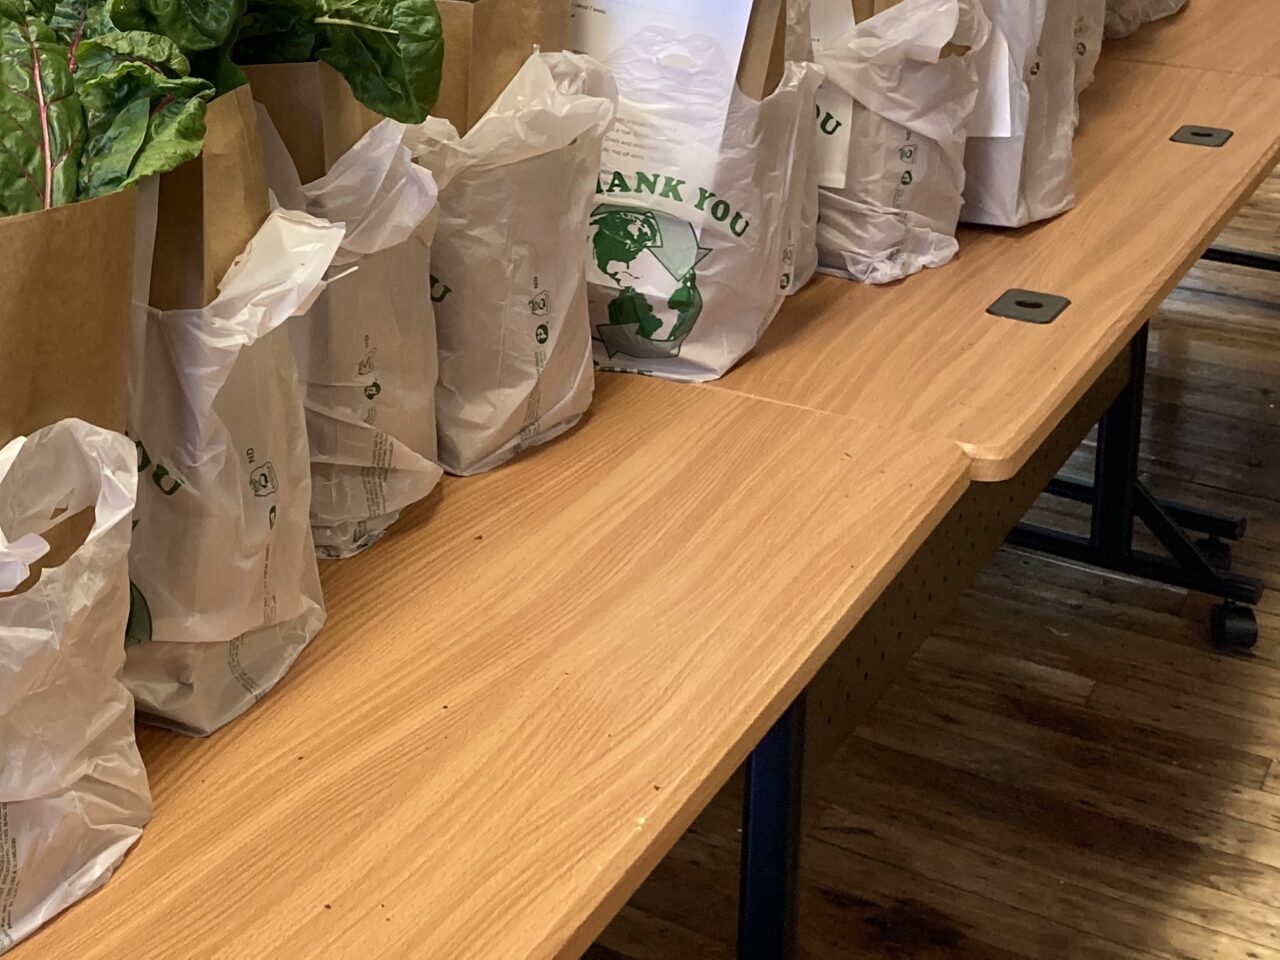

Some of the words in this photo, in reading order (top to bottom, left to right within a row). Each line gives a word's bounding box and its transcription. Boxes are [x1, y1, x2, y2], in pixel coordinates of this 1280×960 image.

[596, 171, 686, 202] ANK
[694, 187, 750, 238] YOU
[134, 440, 184, 496] OU
